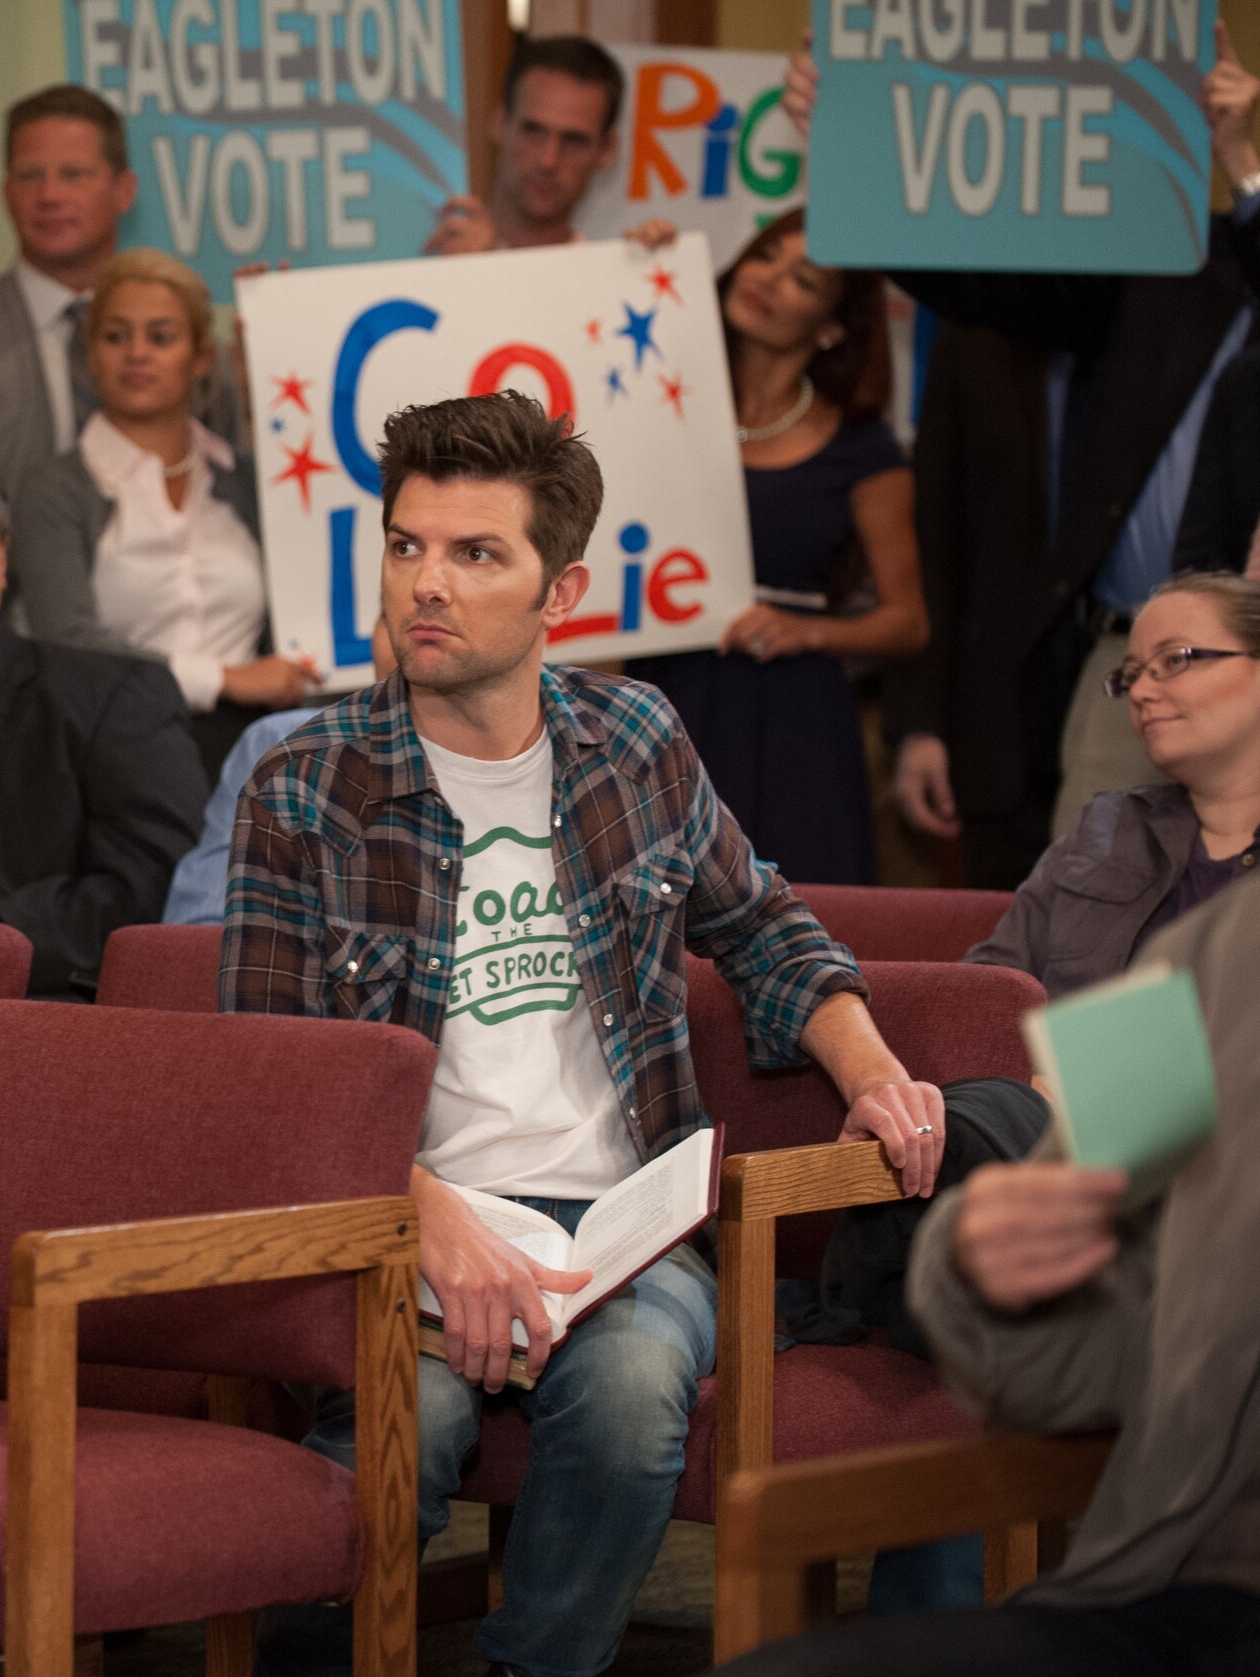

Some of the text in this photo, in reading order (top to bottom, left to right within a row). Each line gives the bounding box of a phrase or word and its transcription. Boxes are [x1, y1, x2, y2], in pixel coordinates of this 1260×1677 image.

[80, 0, 446, 115] EAGLETON
[153, 126, 376, 256] VOTE
[893, 83, 1114, 216] VOTE
[328, 506, 708, 666] Lie
[491, 923, 533, 942] THE
